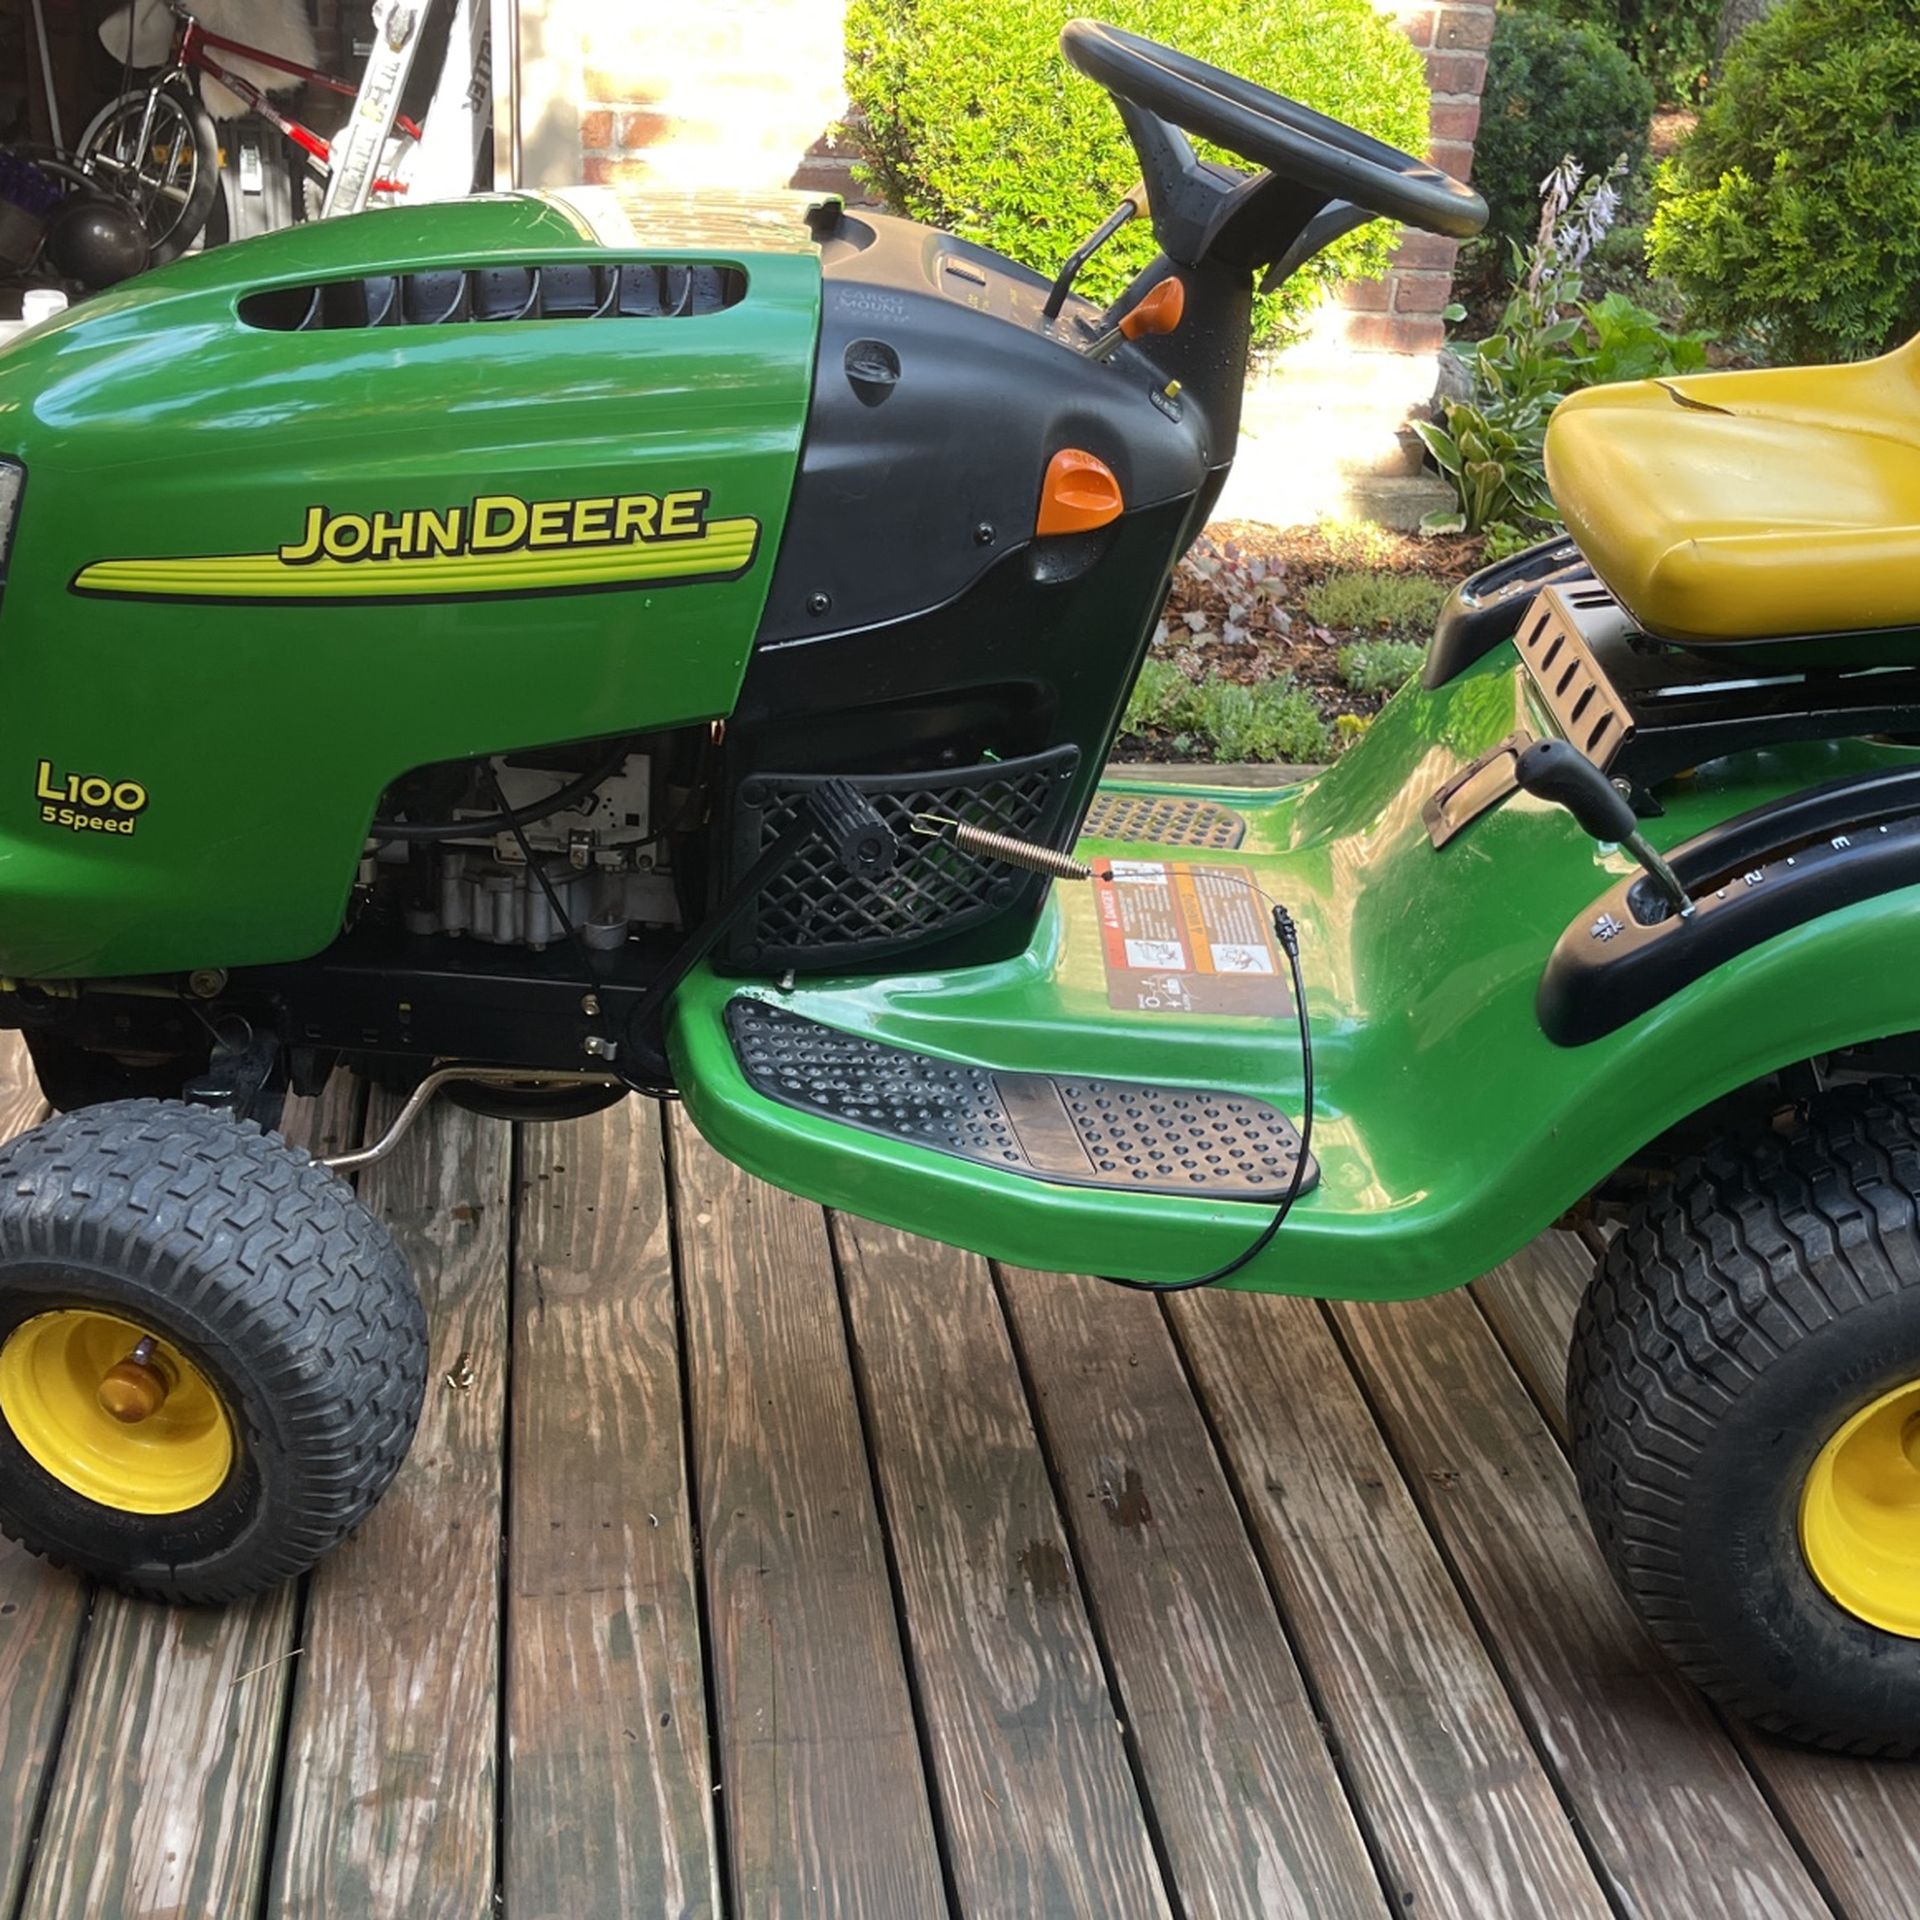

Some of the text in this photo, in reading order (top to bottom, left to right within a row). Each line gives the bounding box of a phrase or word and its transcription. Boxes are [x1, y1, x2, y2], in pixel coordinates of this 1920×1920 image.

[461, 31, 491, 114] ELLER
[839, 296, 905, 315] MOUNT
[279, 491, 706, 562] JOHN DEERE
[37, 760, 147, 812] L100
